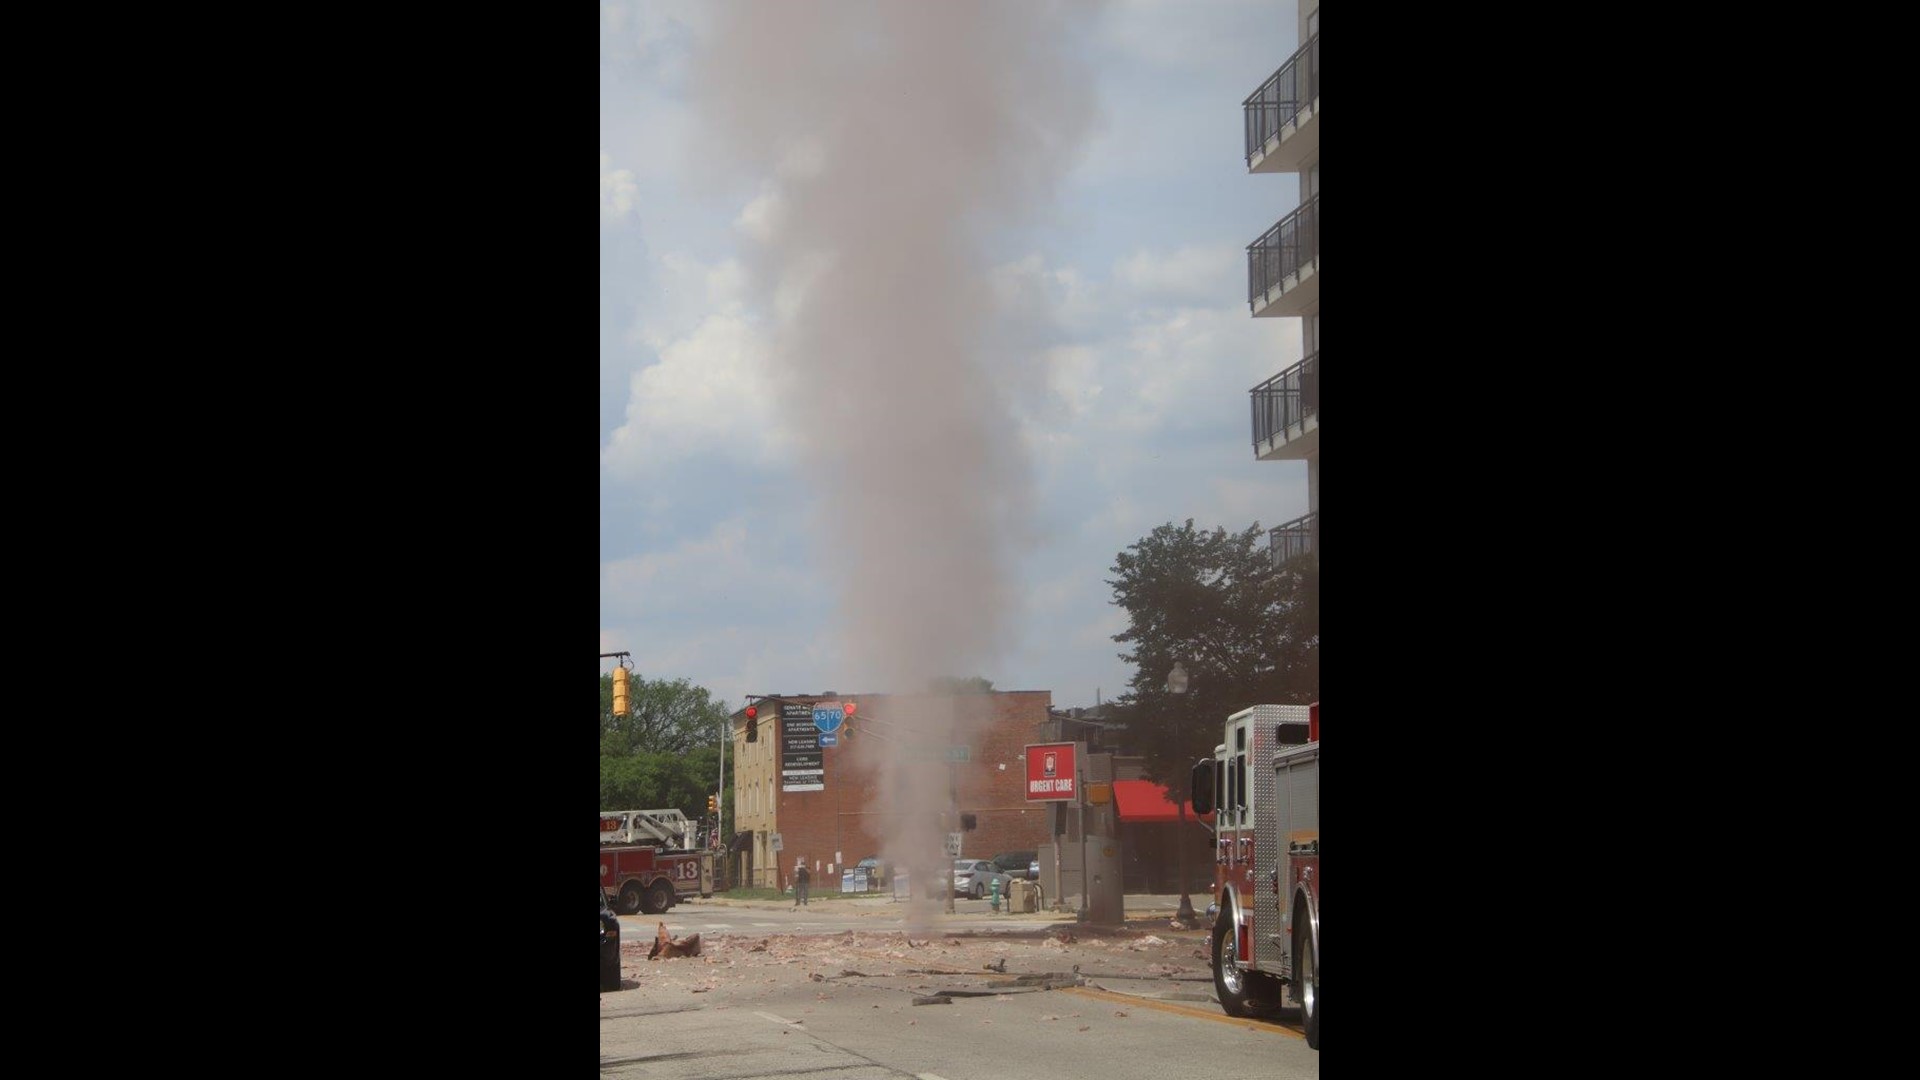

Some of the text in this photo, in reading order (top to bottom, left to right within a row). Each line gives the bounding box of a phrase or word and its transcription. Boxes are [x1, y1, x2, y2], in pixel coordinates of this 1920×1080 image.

[815, 711, 827, 720] 65
[830, 710, 842, 719] 70
[1030, 779, 1072, 792] URGENT CARE
[677, 861, 698, 879] 13
